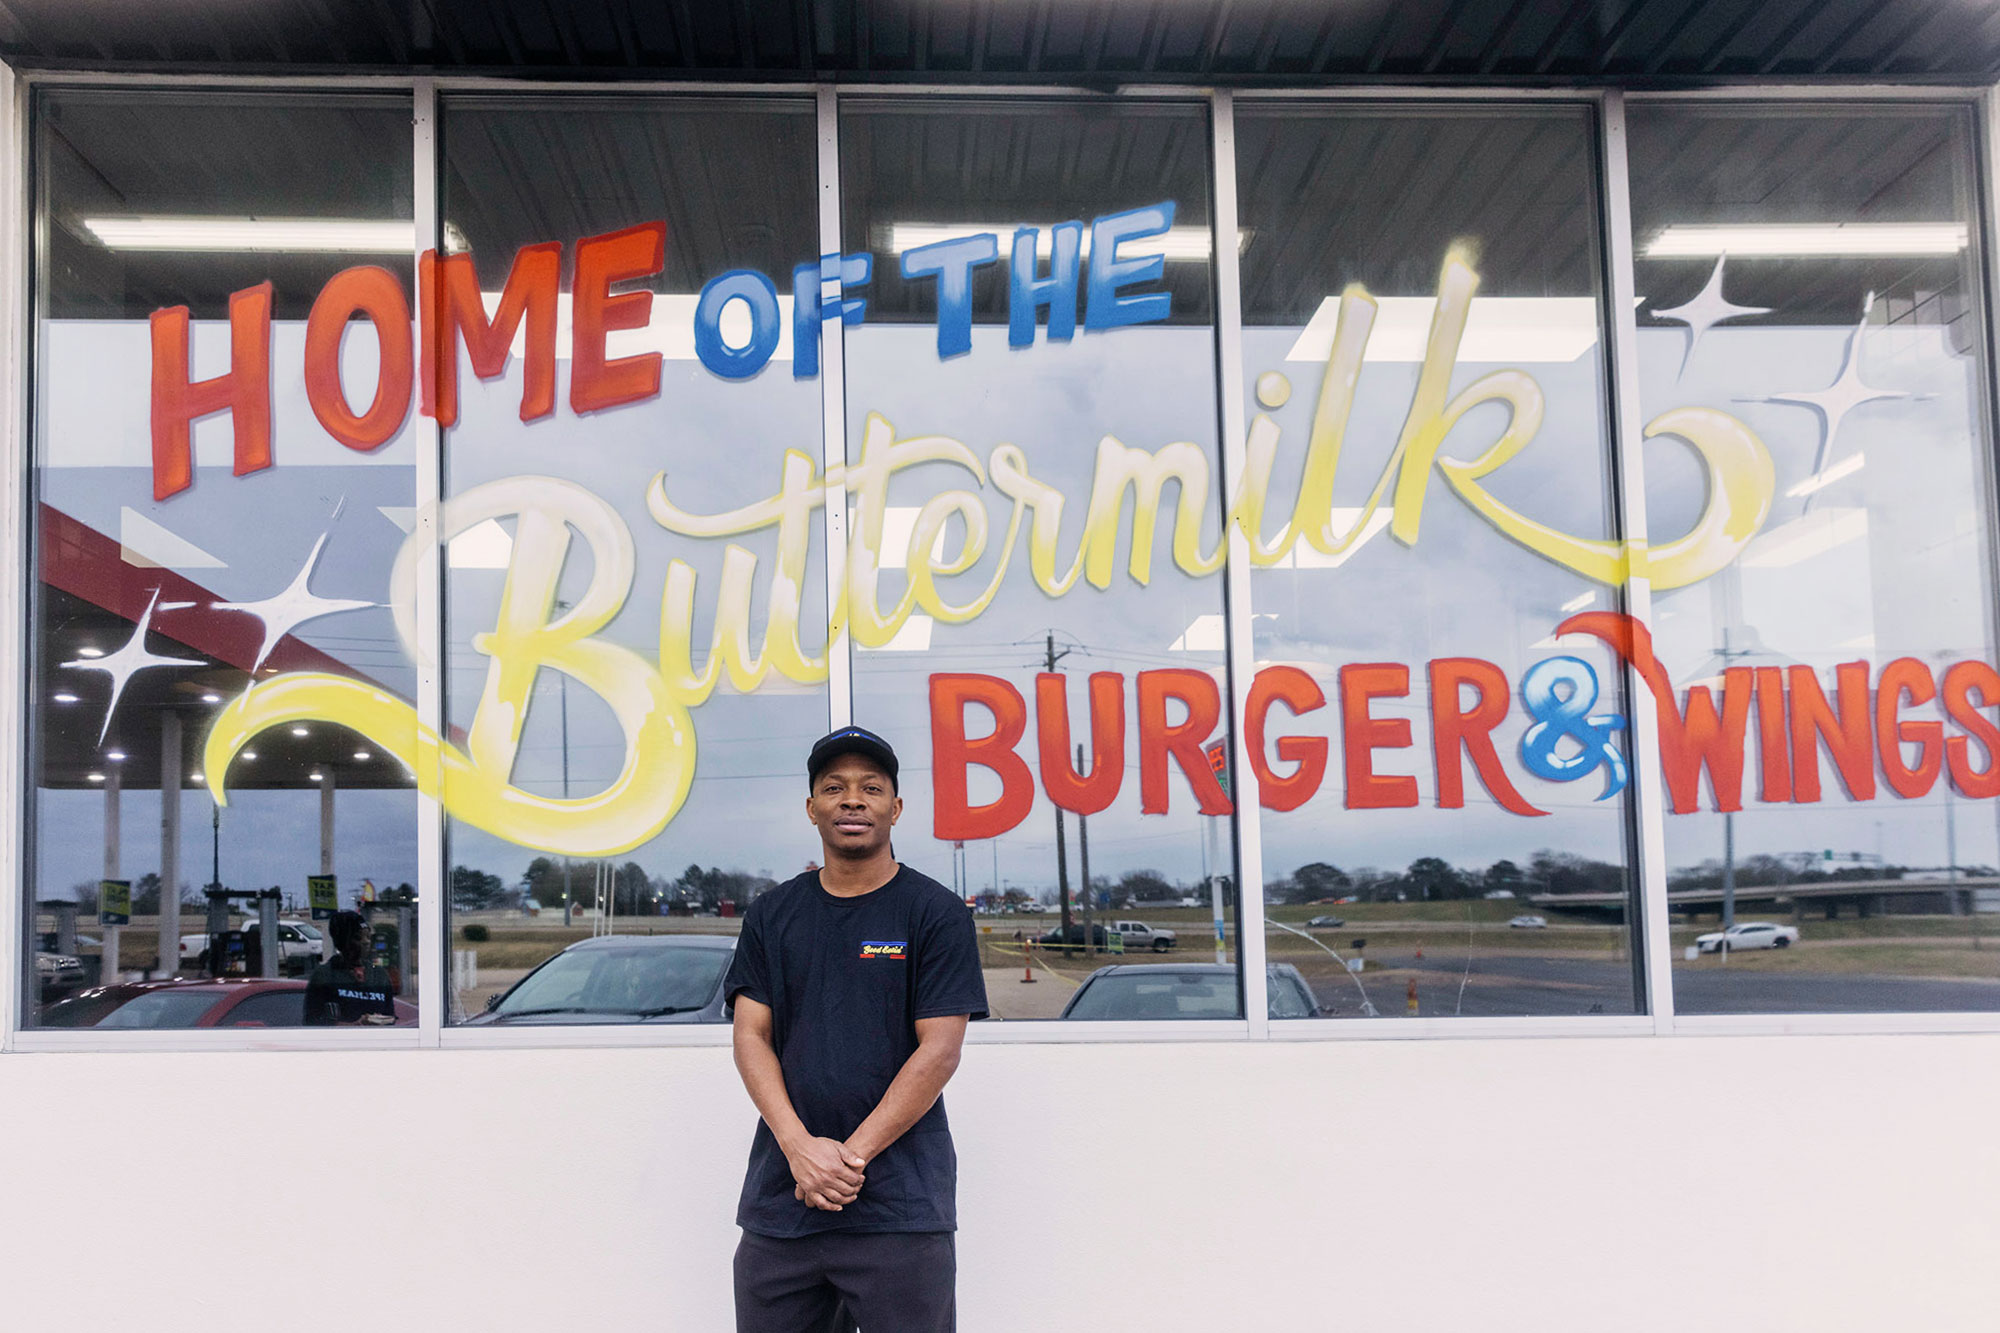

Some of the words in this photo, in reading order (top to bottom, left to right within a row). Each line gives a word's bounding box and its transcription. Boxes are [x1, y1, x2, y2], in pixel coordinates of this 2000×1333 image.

[150, 220, 667, 500] HOME
[694, 252, 873, 381] OF
[902, 200, 1176, 361] THE
[204, 237, 1775, 857] Buttermilk
[929, 657, 1552, 840] BURGER
[1521, 655, 1629, 802] &
[1555, 611, 2000, 815] WINGS
